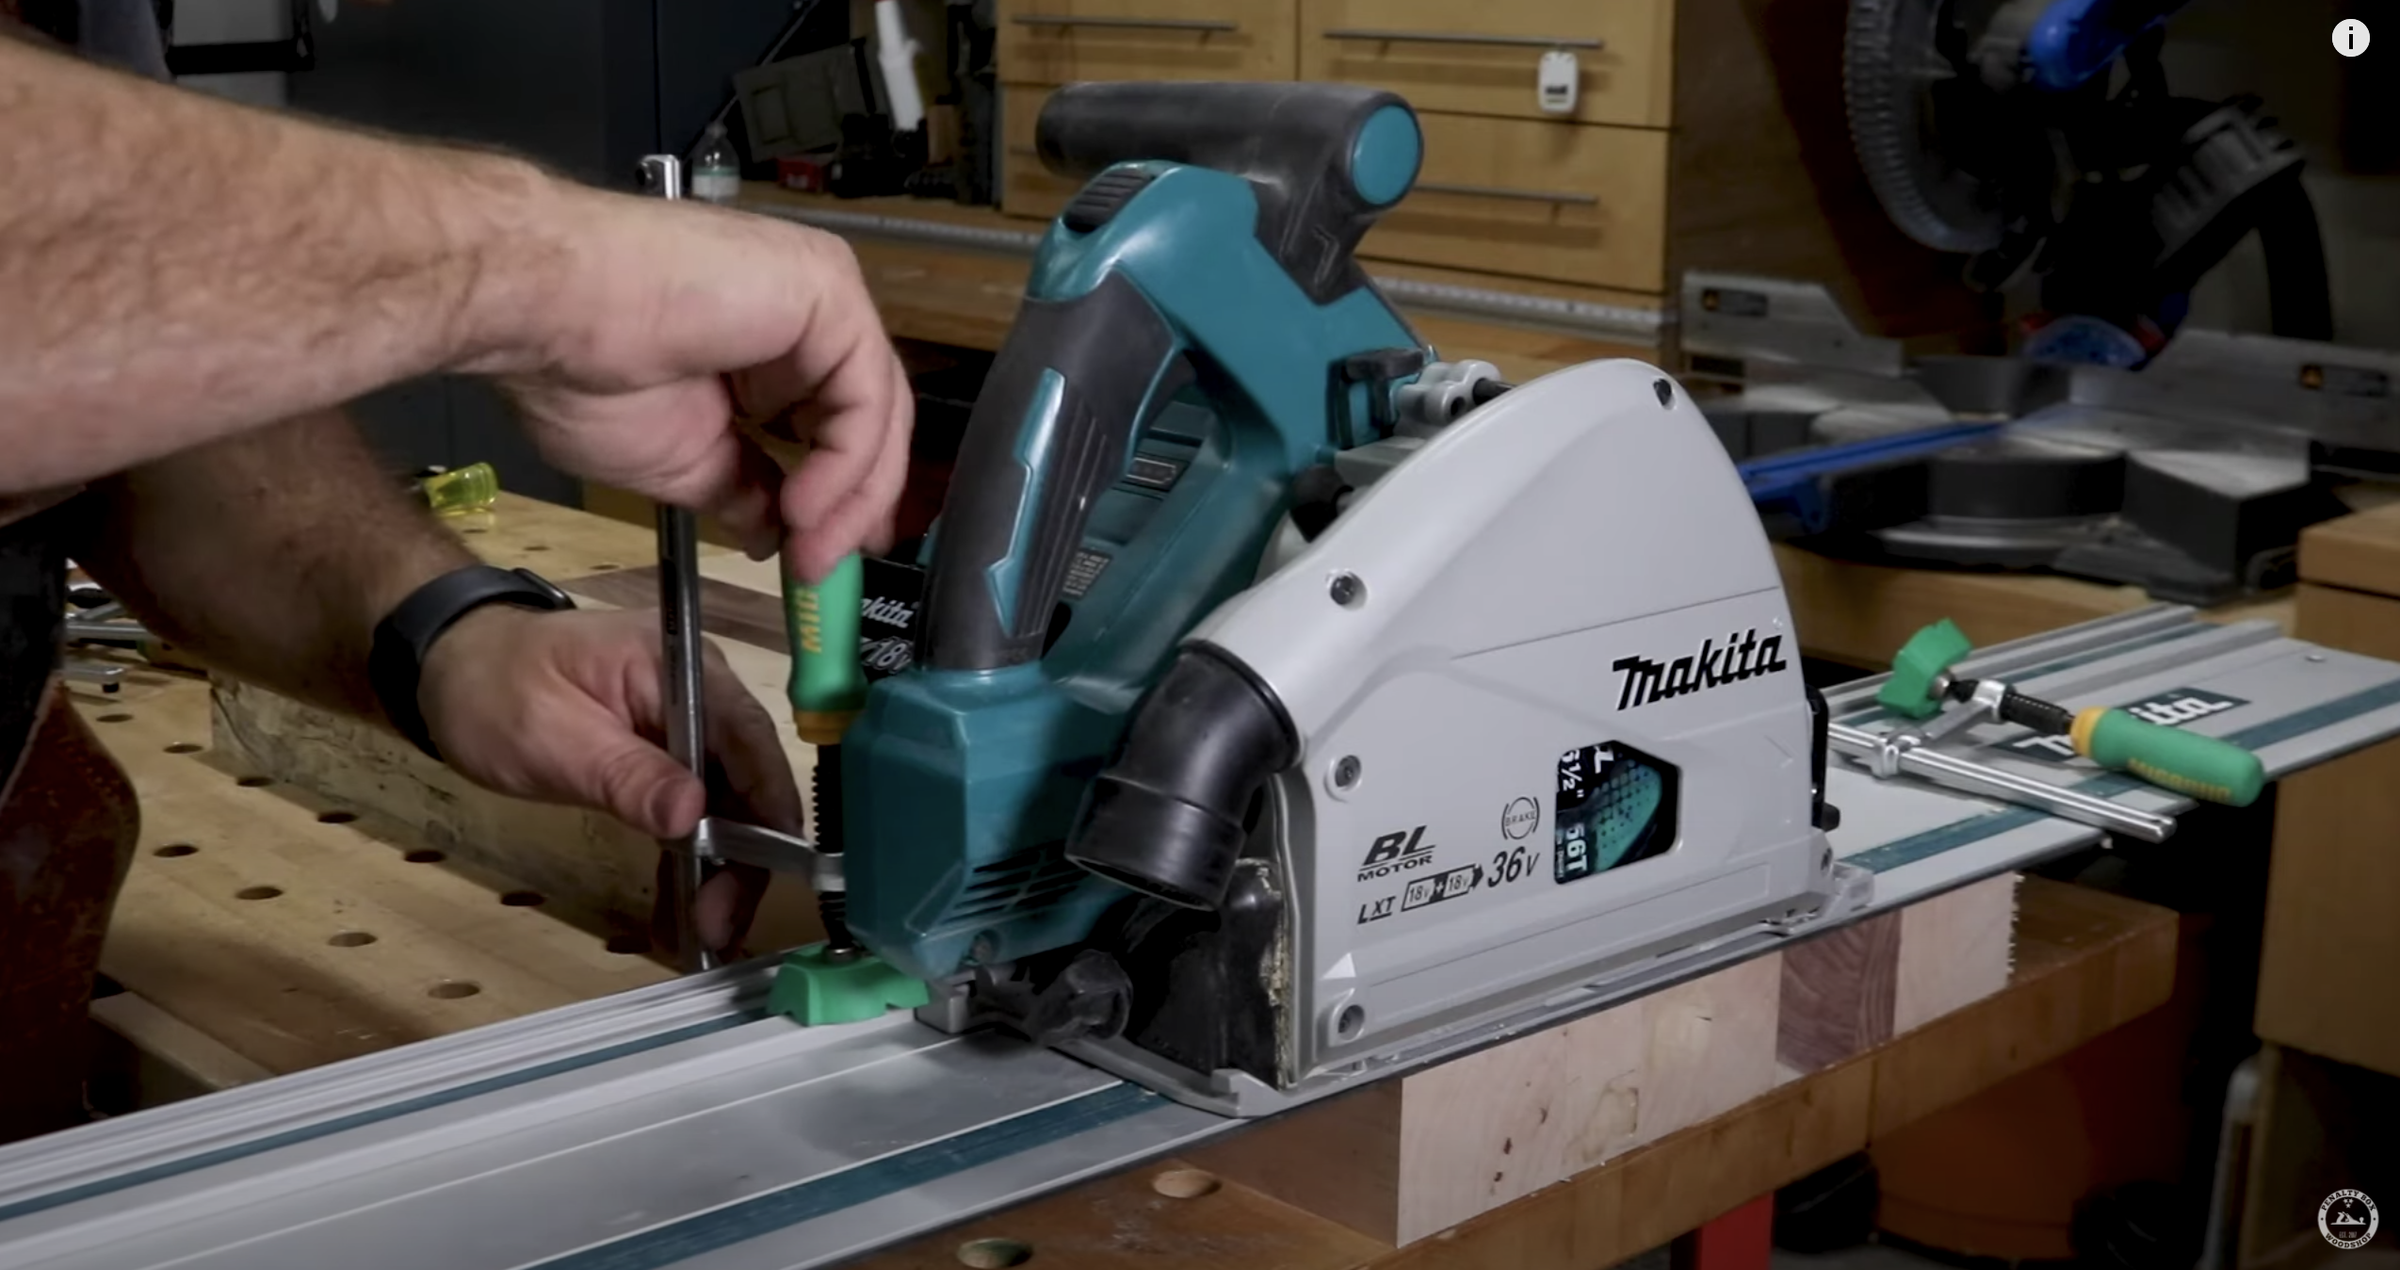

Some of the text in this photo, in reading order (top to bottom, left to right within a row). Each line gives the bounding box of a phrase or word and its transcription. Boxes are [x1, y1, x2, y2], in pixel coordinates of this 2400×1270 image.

[1612, 627, 1787, 712] Makita
[1505, 810, 1536, 827] BRAKE
[1362, 825, 1436, 866] BL
[1566, 822, 1588, 871] 56T
[1357, 855, 1434, 882] MOTOR
[1357, 896, 1396, 924] LXT
